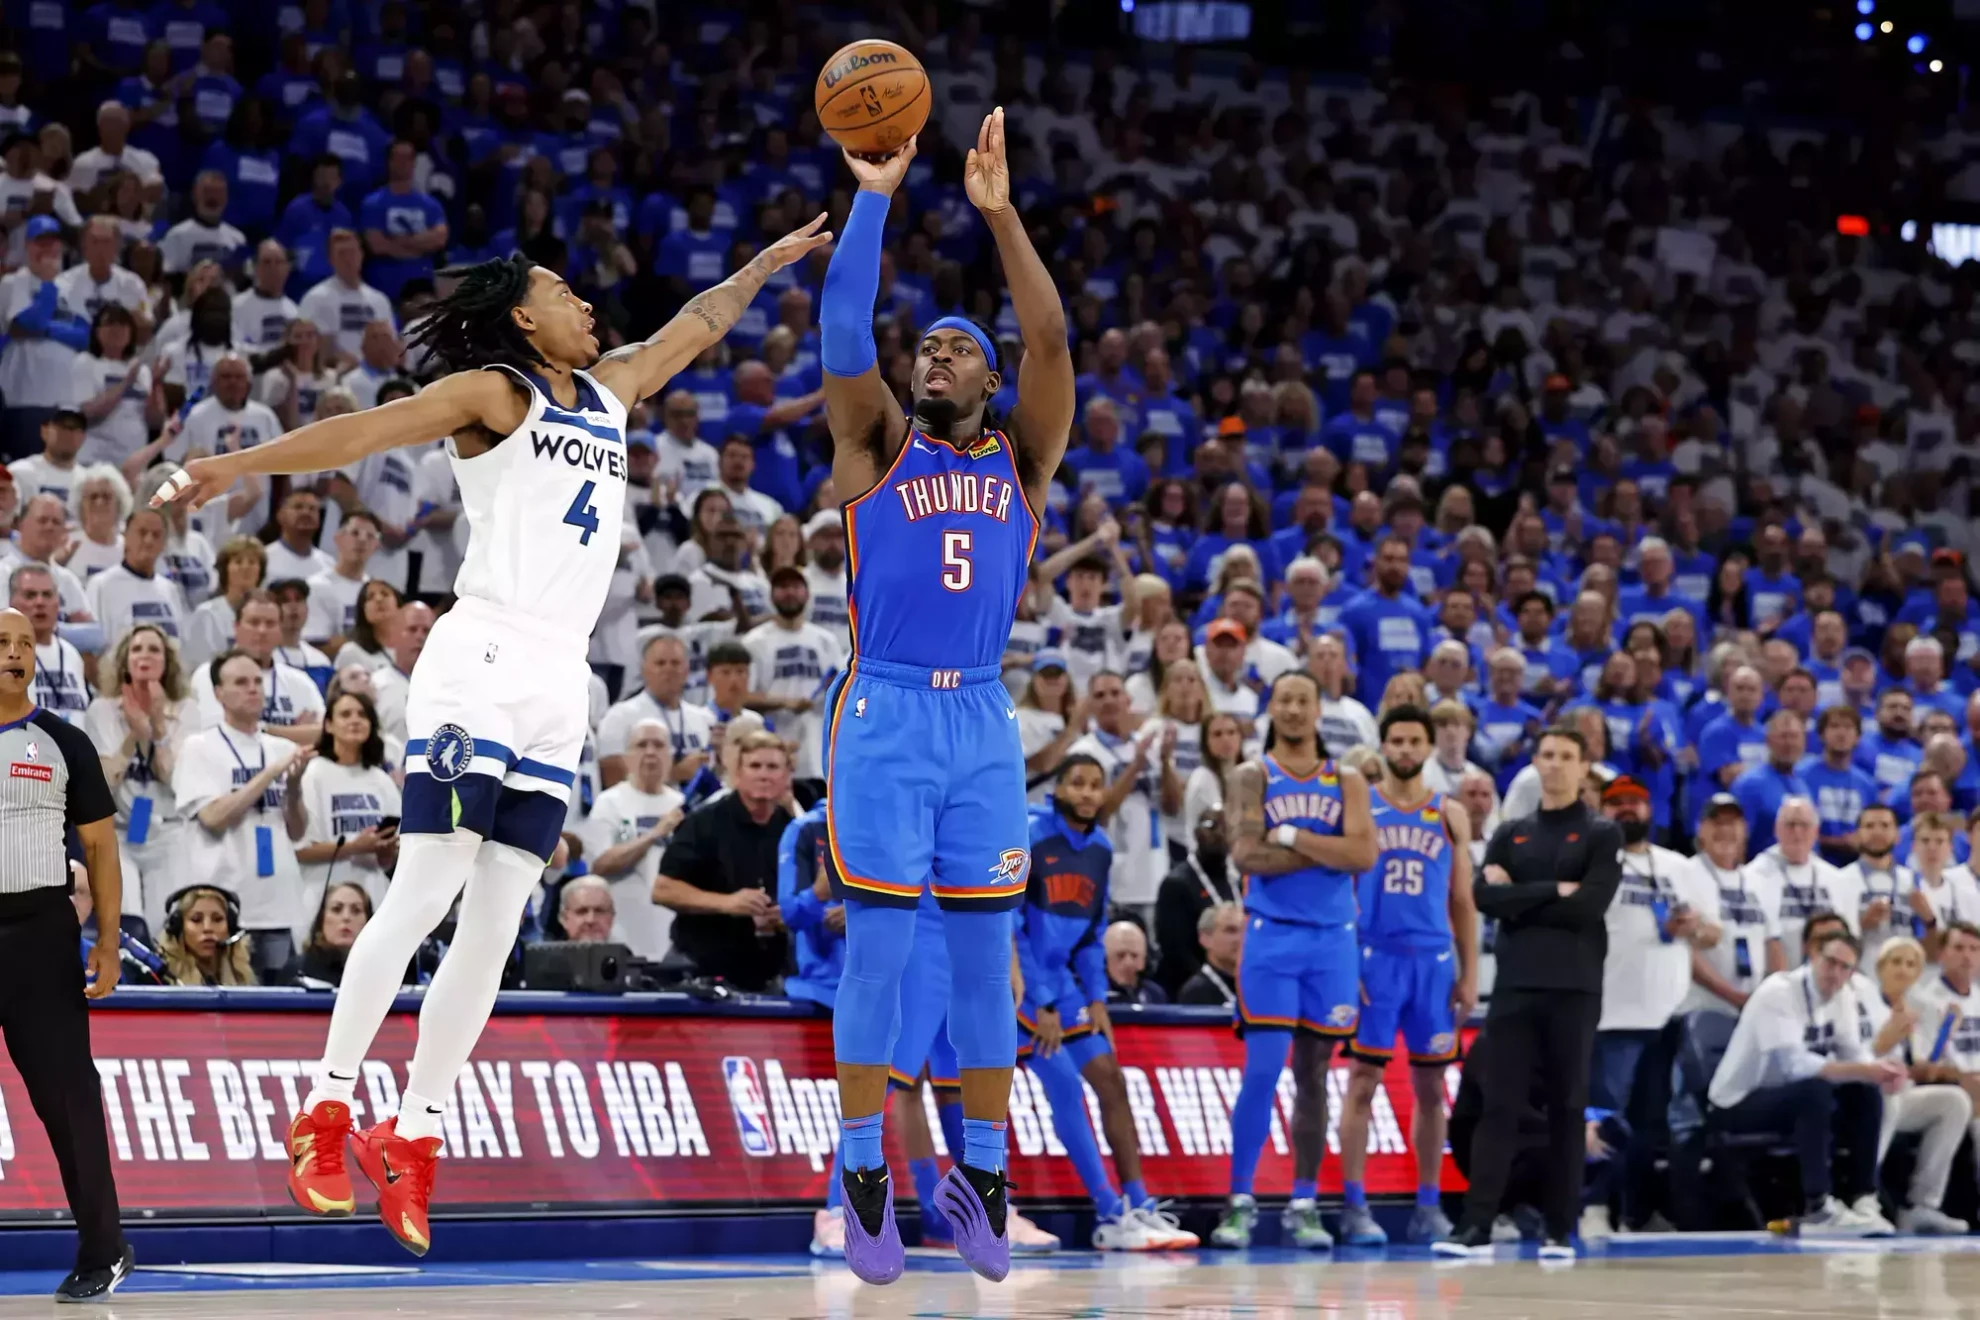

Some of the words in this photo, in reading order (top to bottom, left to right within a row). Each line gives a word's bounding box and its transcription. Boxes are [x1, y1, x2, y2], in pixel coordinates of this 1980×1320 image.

[823, 53, 897, 88] Wilson
[530, 430, 627, 481] WOLVES
[562, 480, 600, 547] 4
[895, 471, 1013, 524] THUNDER
[942, 530, 973, 593] 5
[931, 671, 961, 689] OKC
[11, 765, 52, 779] Emirates
[1376, 825, 1445, 860] HUNDER
[1383, 857, 1424, 896] 25
[93, 1059, 210, 1161] THE
[521, 1060, 600, 1158] TO
[597, 1060, 711, 1157] NBA
